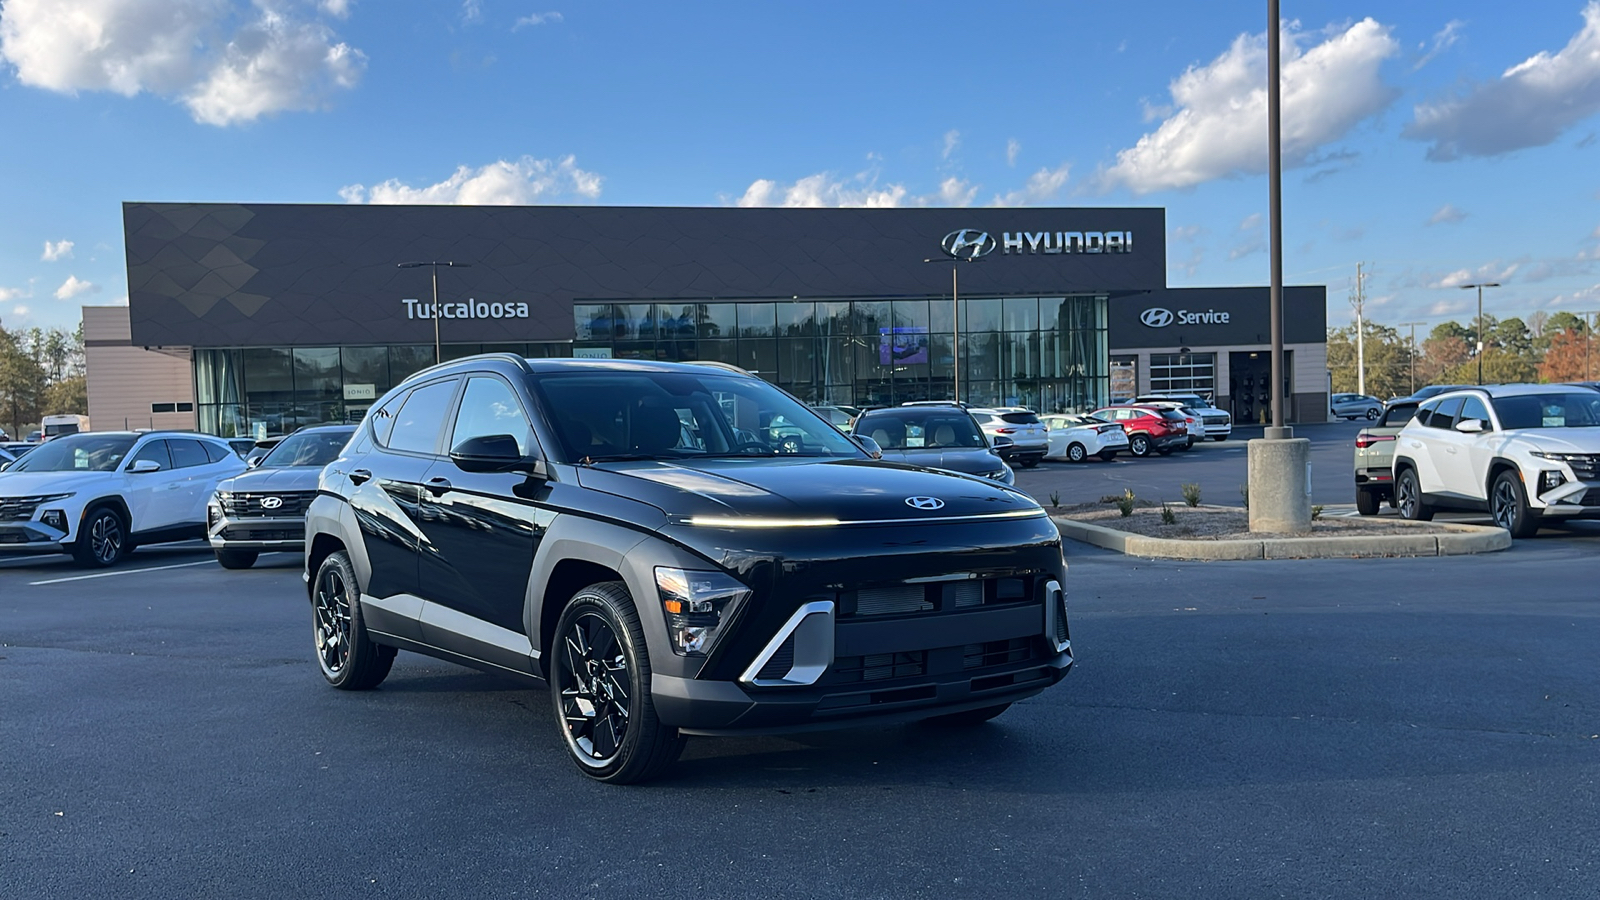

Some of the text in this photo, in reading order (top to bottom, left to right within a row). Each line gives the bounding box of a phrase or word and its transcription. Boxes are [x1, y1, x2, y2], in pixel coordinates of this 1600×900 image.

[1003, 231, 1133, 254] HYUNDAI
[402, 298, 529, 319] Tuscaloosa
[1177, 309, 1230, 325] Service
